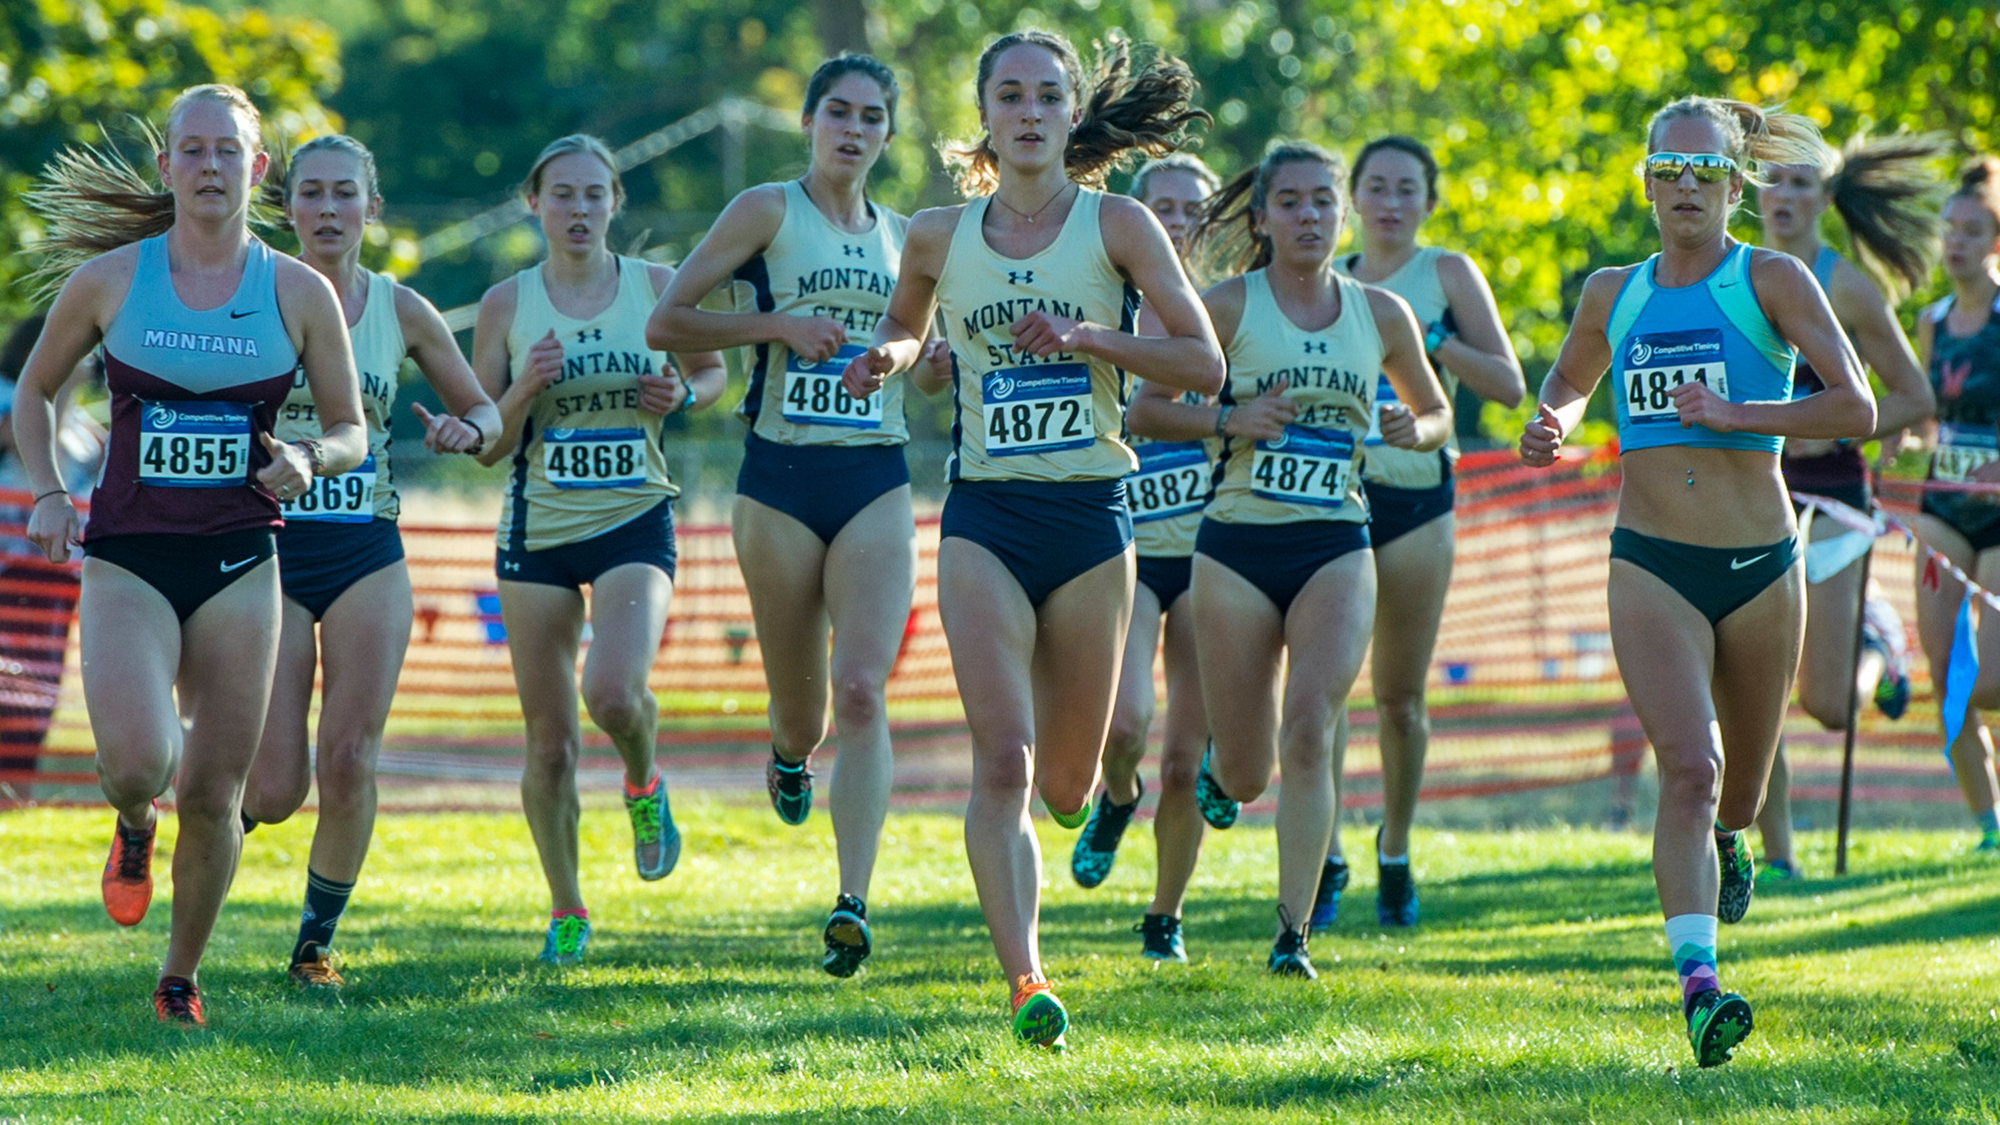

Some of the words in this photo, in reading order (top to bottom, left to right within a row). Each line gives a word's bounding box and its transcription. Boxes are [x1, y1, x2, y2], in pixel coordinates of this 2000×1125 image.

[797, 268, 896, 299] MONTAN
[963, 298, 1085, 340] MONTANA
[142, 329, 259, 358] MONTANA
[1653, 344, 1693, 355] Competitive
[1693, 342, 1720, 352] Timing
[546, 351, 652, 390] NTANA
[1016, 378, 1061, 389] Competitive
[1061, 376, 1087, 386] Timing
[1256, 366, 1367, 403] MONTANA
[178, 413, 223, 423] Competitive
[223, 414, 248, 423] Timing
[556, 387, 638, 417] STATE
[1299, 404, 1351, 424] ATE
[989, 400, 1082, 444] 4872
[144, 436, 238, 475] 4855
[548, 444, 634, 478] 4868
[1125, 469, 1205, 512] 4882
[1255, 455, 1338, 495] 4874
